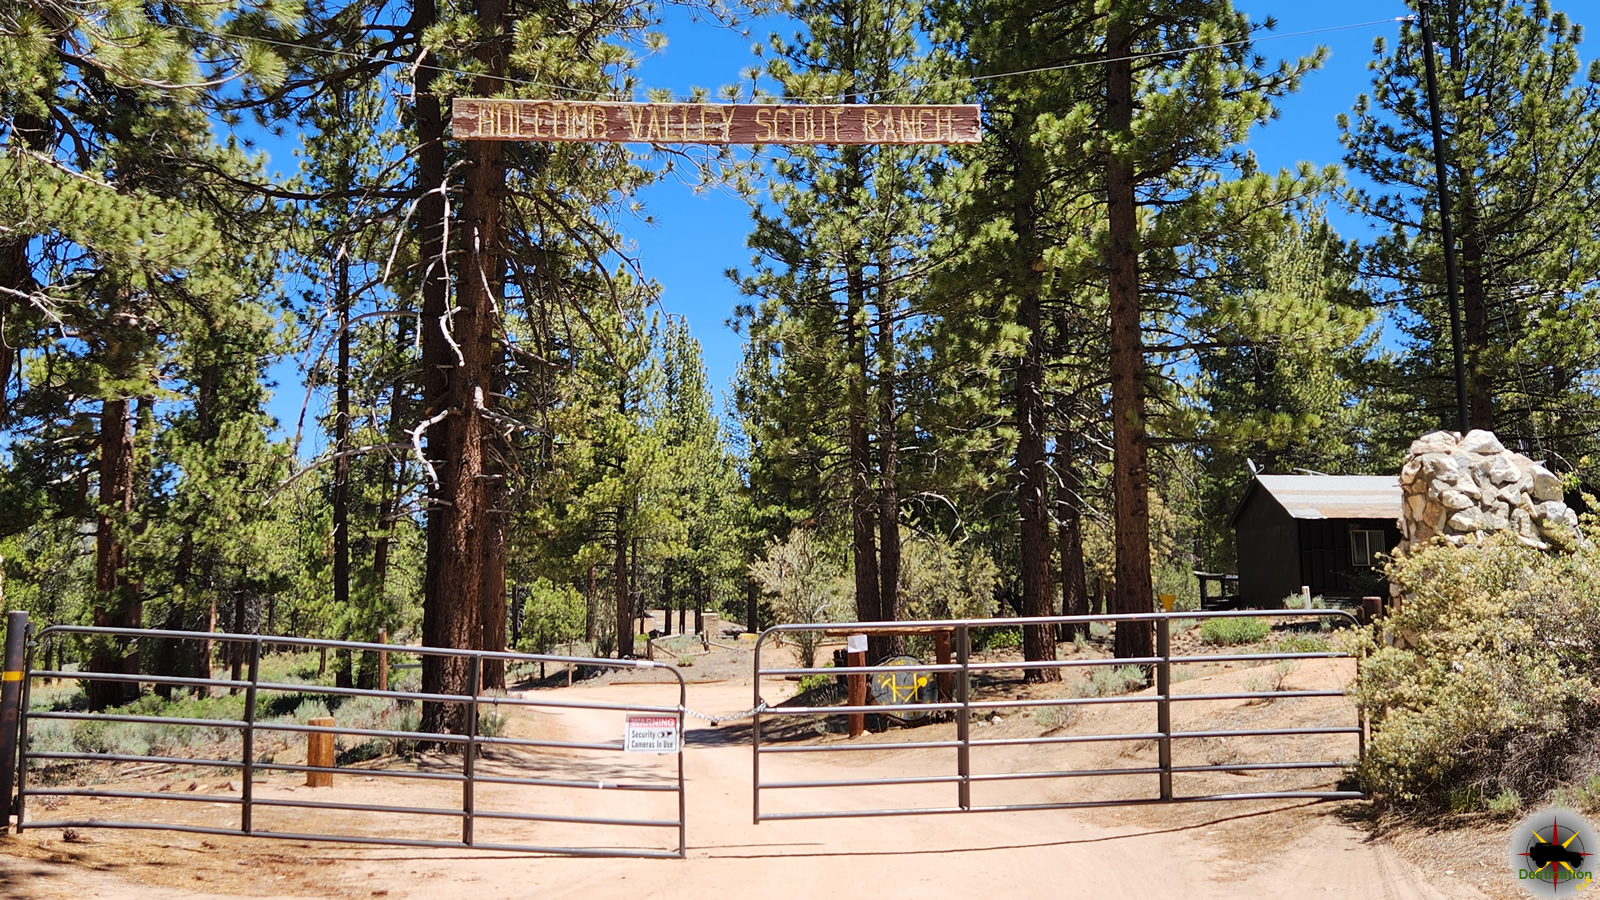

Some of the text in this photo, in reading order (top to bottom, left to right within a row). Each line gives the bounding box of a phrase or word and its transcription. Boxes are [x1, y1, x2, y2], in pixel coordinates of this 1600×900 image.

[478, 103, 954, 142] HOLCOMB VALLEY SCOUT RANCH
[631, 718, 674, 727] WARNING
[631, 730, 655, 739] Security
[631, 740, 673, 748] Cameras In Use
